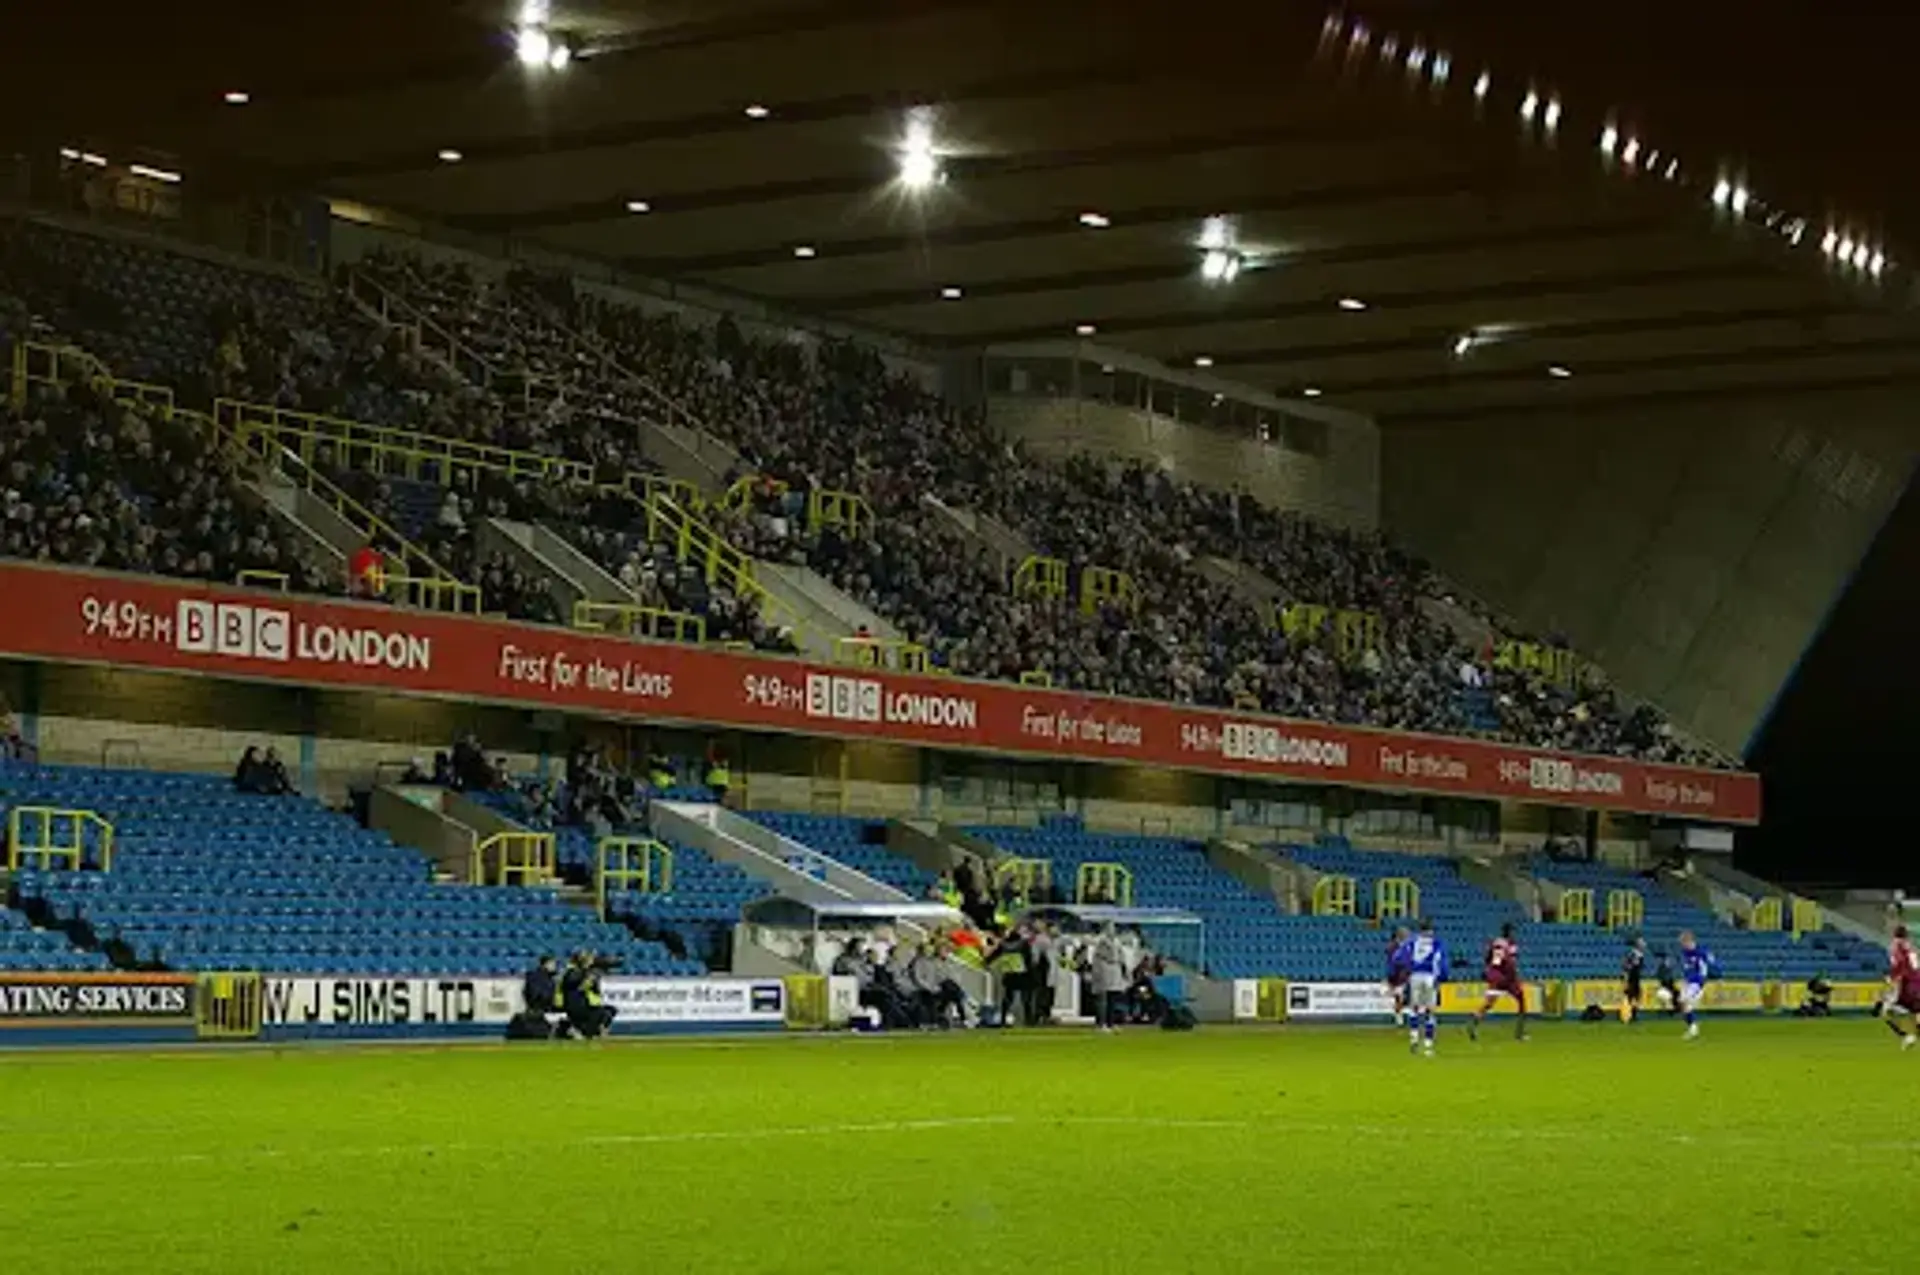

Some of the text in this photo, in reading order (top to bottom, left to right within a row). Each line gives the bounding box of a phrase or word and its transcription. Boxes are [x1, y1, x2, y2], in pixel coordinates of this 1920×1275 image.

[178, 600, 290, 660] BBC
[298, 623, 431, 671] LONDON
[500, 644, 673, 698] First for the Lions
[807, 674, 882, 721] BBC
[885, 692, 977, 728] LONDON
[75, 986, 185, 1012] SERVICES
[262, 983, 293, 1022] W
[304, 982, 321, 1021] J
[333, 982, 409, 1022] SIMS
[424, 982, 475, 1022] LTD
